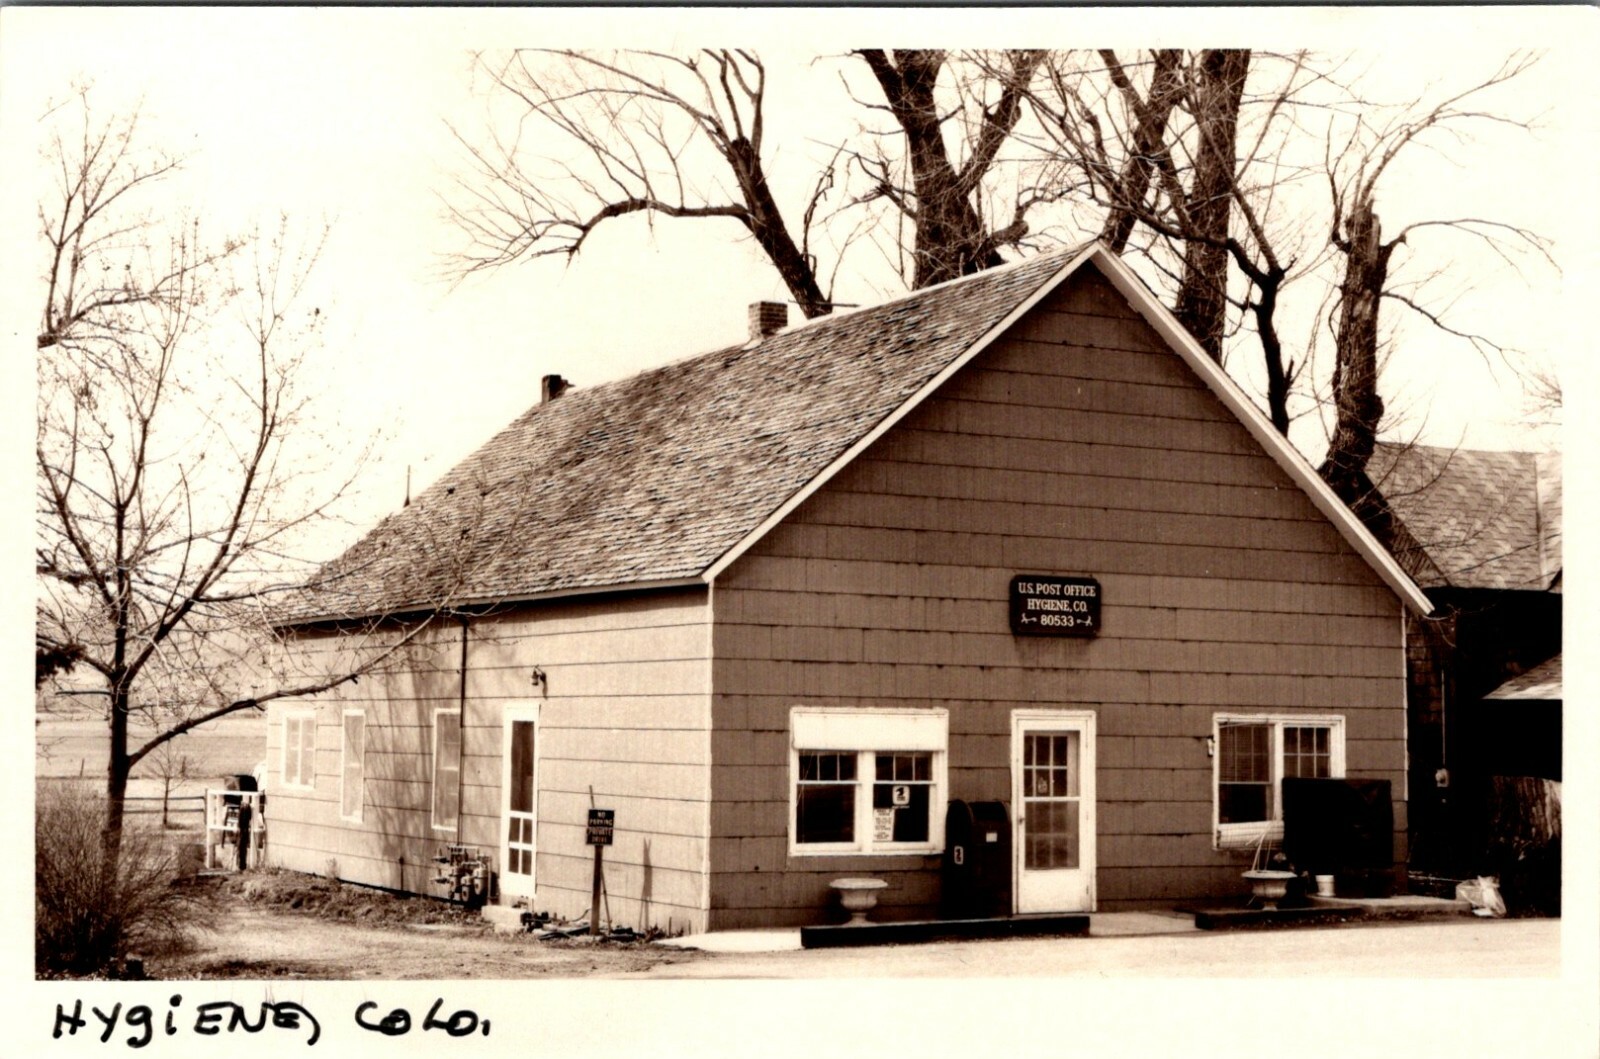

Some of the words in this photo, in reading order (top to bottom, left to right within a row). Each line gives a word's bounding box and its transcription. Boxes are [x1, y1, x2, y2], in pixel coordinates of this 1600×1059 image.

[1036, 583, 1061, 595] POST
[1064, 584, 1096, 597] OFFICE
[1027, 598, 1072, 612] HYGIENE,
[1040, 614, 1074, 627] 80533
